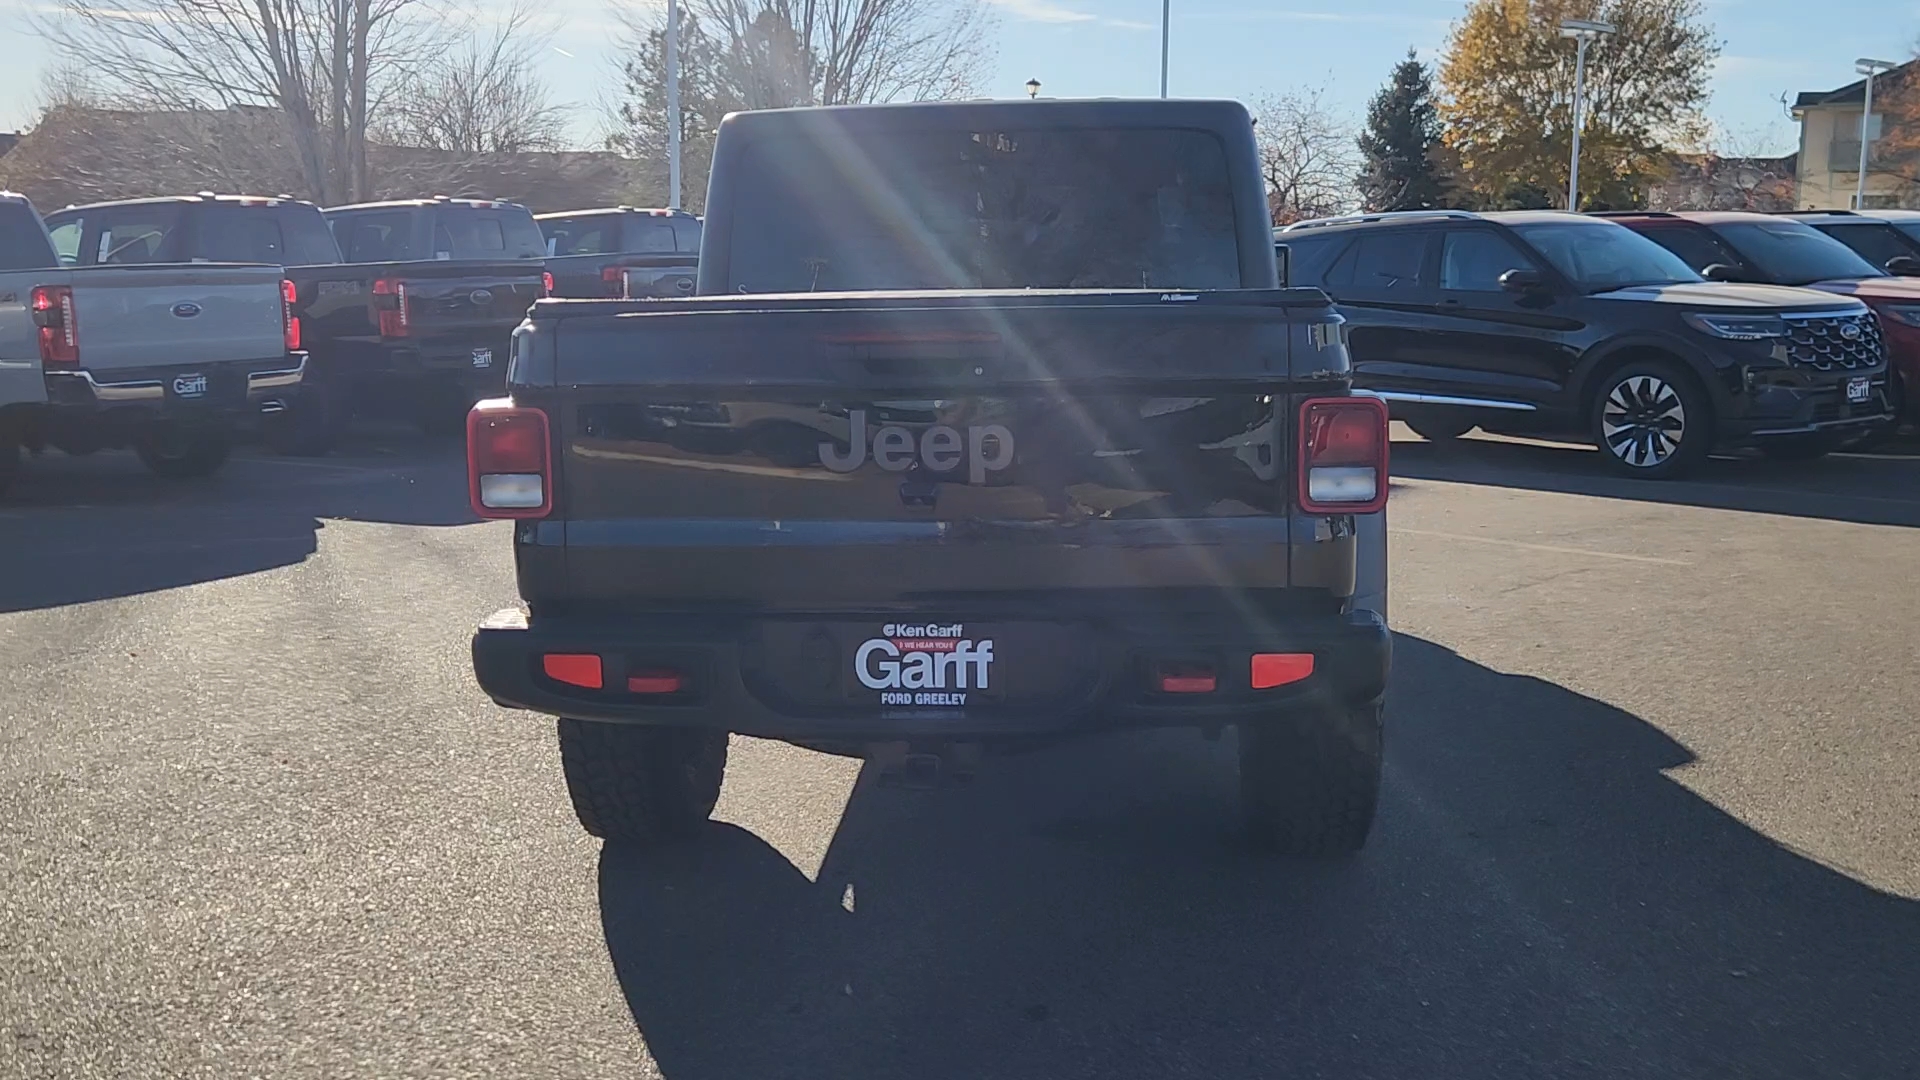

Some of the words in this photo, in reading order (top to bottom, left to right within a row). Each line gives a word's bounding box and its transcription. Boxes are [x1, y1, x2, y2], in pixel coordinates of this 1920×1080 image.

[173, 376, 208, 394] Garff
[1847, 381, 1869, 398] Garff
[818, 410, 1014, 484] Jeep
[896, 624, 925, 637] Ken
[925, 623, 963, 637] Garff
[904, 641, 915, 649] WE
[916, 641, 934, 649] HEAR
[935, 641, 949, 649] YOU
[855, 638, 994, 690] Garff
[881, 692, 912, 705] FORD
[915, 692, 967, 706] GREELEY
